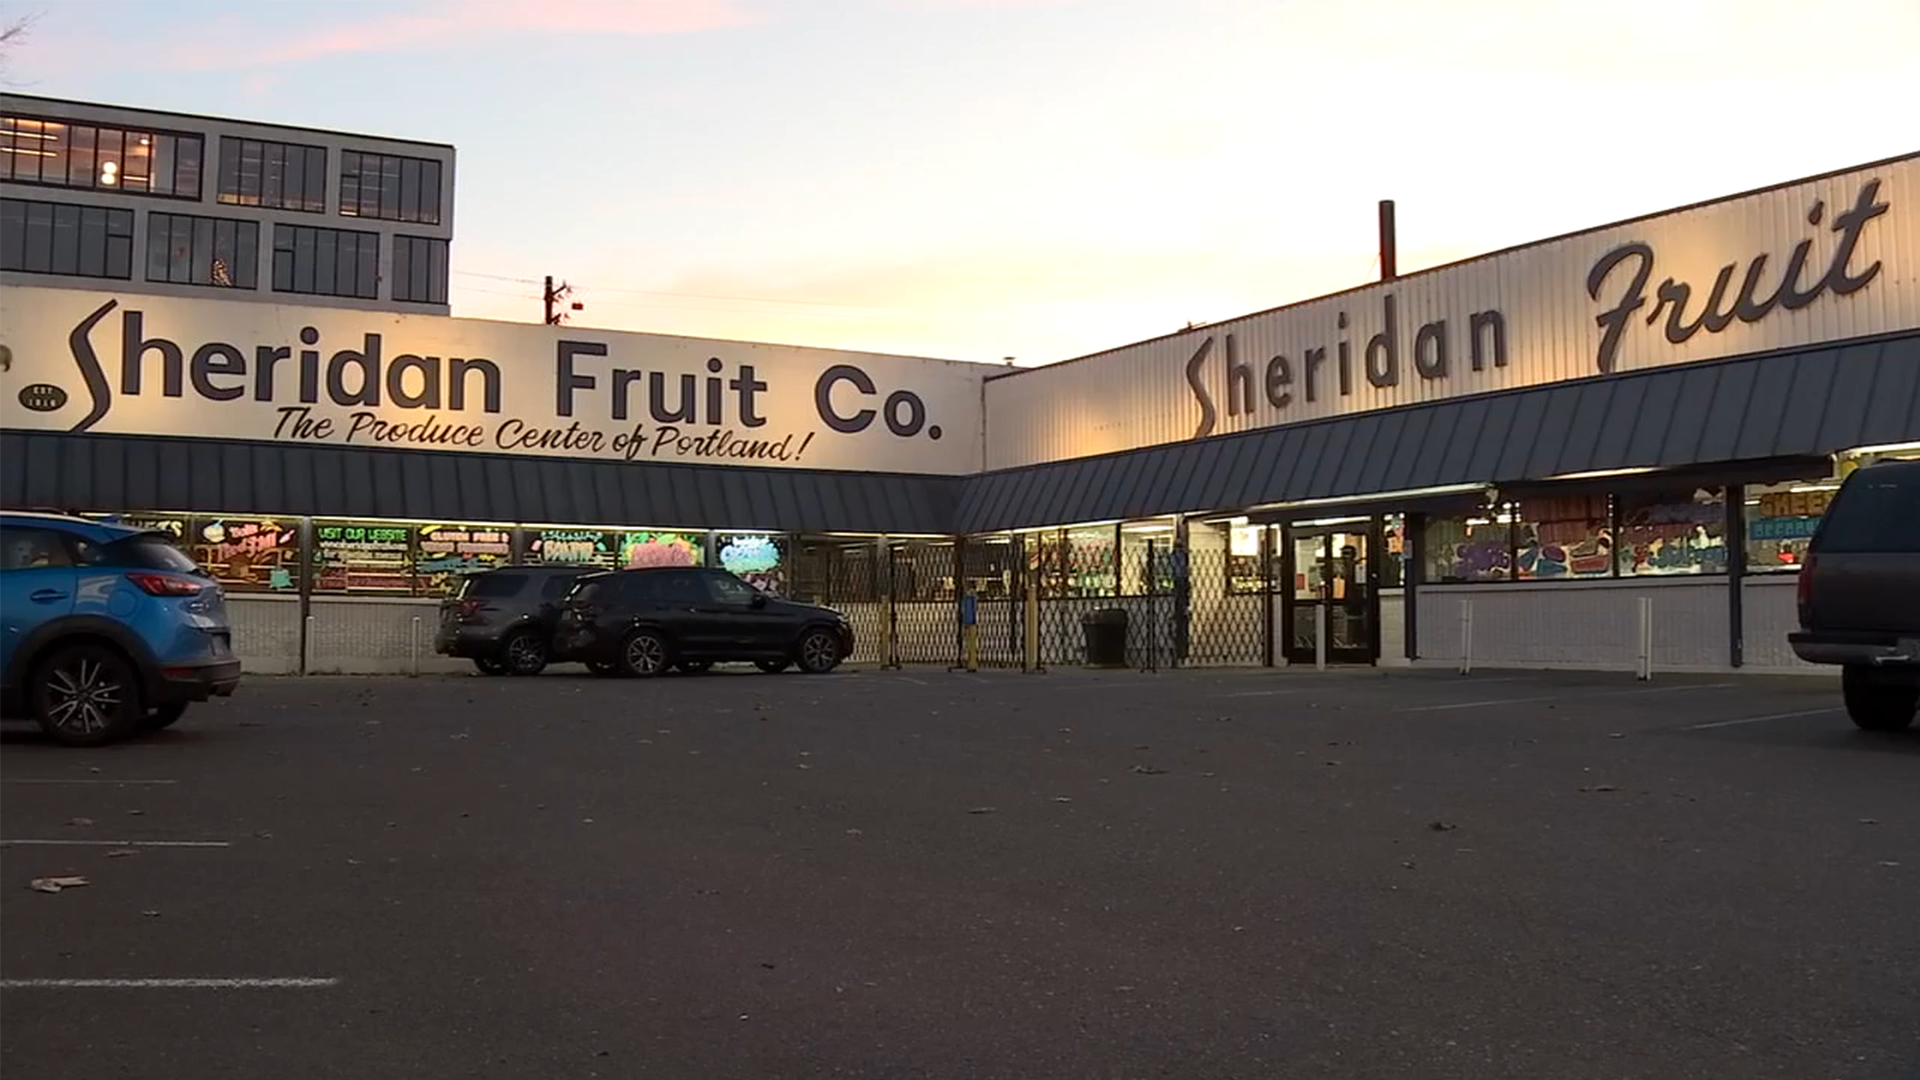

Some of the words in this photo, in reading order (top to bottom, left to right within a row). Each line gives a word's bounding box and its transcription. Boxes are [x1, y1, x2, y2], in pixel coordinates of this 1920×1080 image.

[1185, 293, 1508, 440] Sheridan
[1587, 177, 1889, 374] Fruit
[69, 298, 500, 433] Sheridan
[556, 339, 768, 428] Fruit
[814, 364, 943, 440] Co.
[273, 406, 336, 440] The
[346, 411, 484, 447] Produce
[495, 418, 605, 452] Center
[612, 426, 648, 461] of
[651, 426, 815, 462] Portland!
[345, 528, 366, 540] OUR
